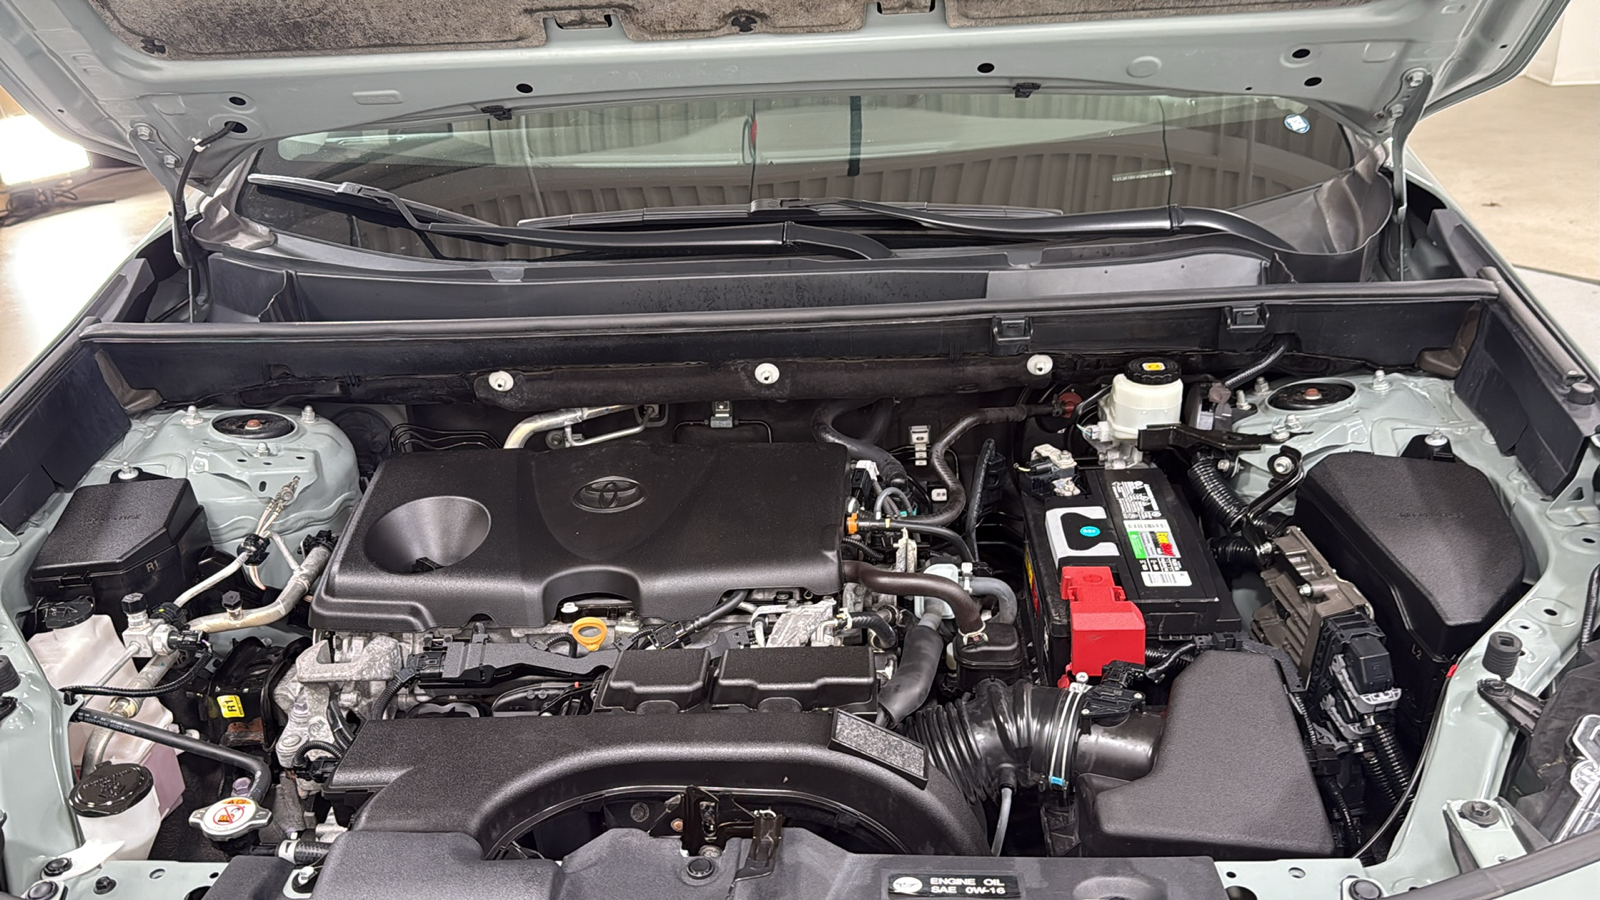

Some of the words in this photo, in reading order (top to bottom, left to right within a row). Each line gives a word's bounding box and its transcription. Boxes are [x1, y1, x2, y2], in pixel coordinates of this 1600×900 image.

[145, 559, 159, 572] R1
[224, 700, 237, 712] R1
[930, 877, 976, 886] ENGINE
[983, 878, 1005, 886] OIL
[931, 886, 957, 894] SAE
[965, 886, 1006, 894] 0W-16
